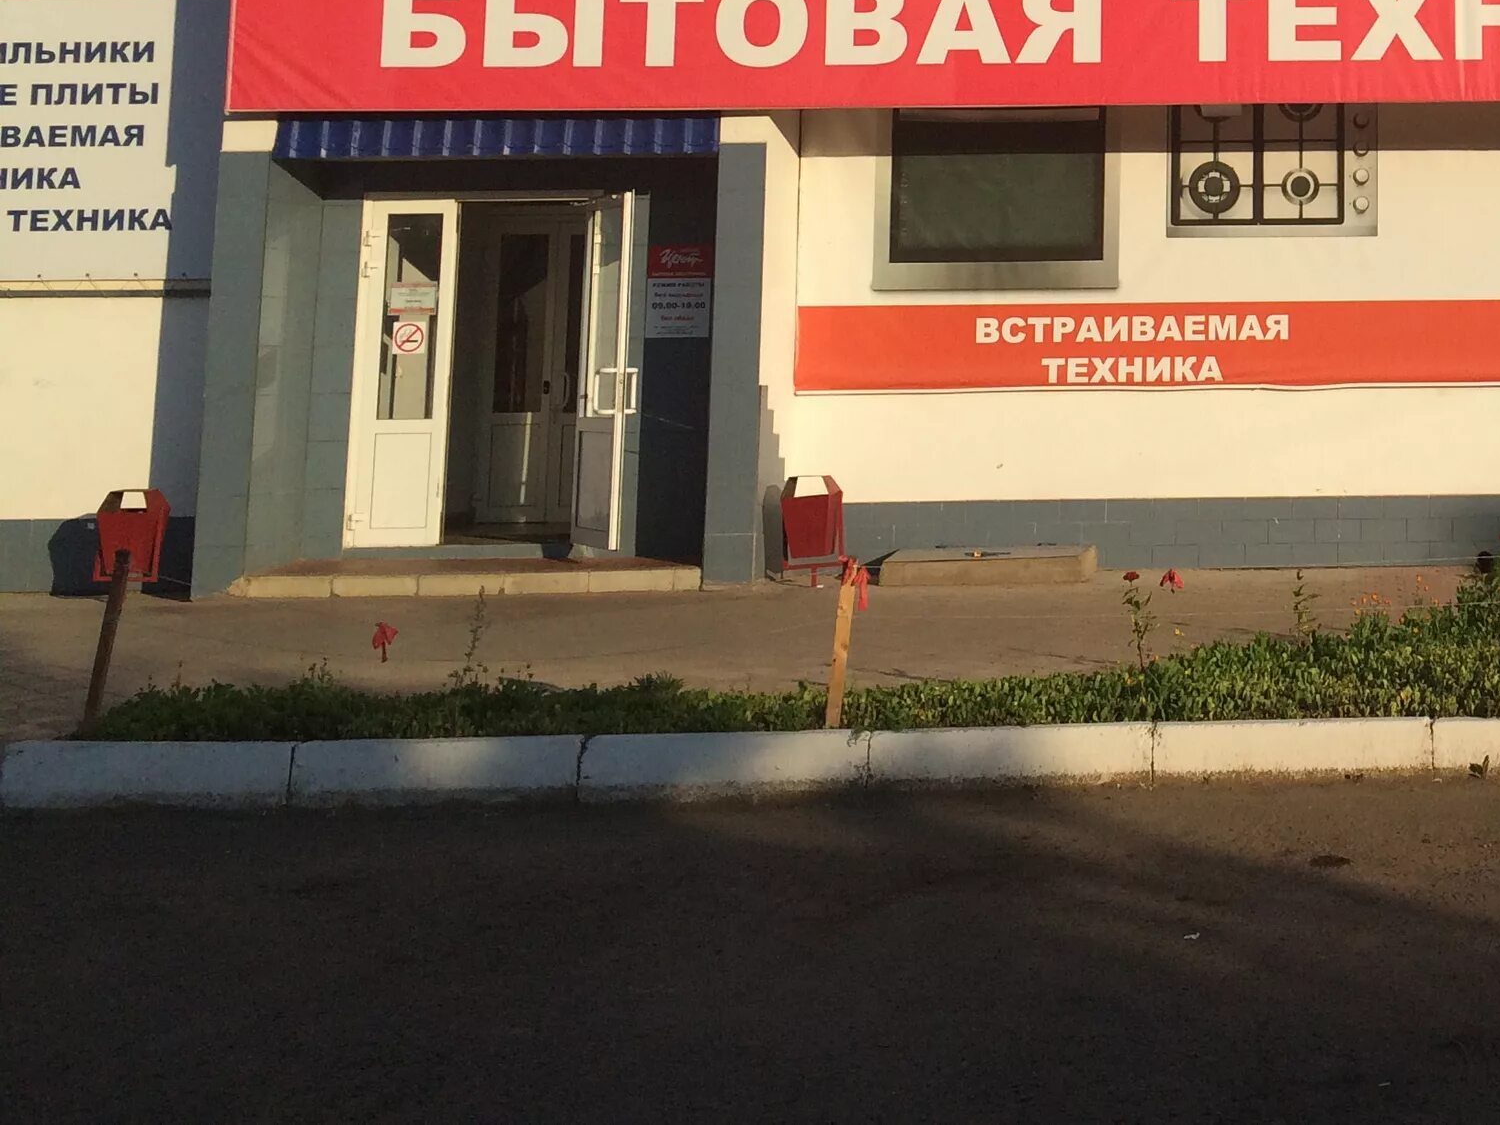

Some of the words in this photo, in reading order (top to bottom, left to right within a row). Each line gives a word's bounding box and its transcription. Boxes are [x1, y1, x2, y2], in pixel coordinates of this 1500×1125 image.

[30, 82, 159, 106] ПЛИТЫ
[7, 208, 172, 232] ТЕХНИКА
[975, 314, 1290, 344] ВСТРАИВАЕМАЯ
[1041, 354, 1224, 383] ТЕХНИКА
